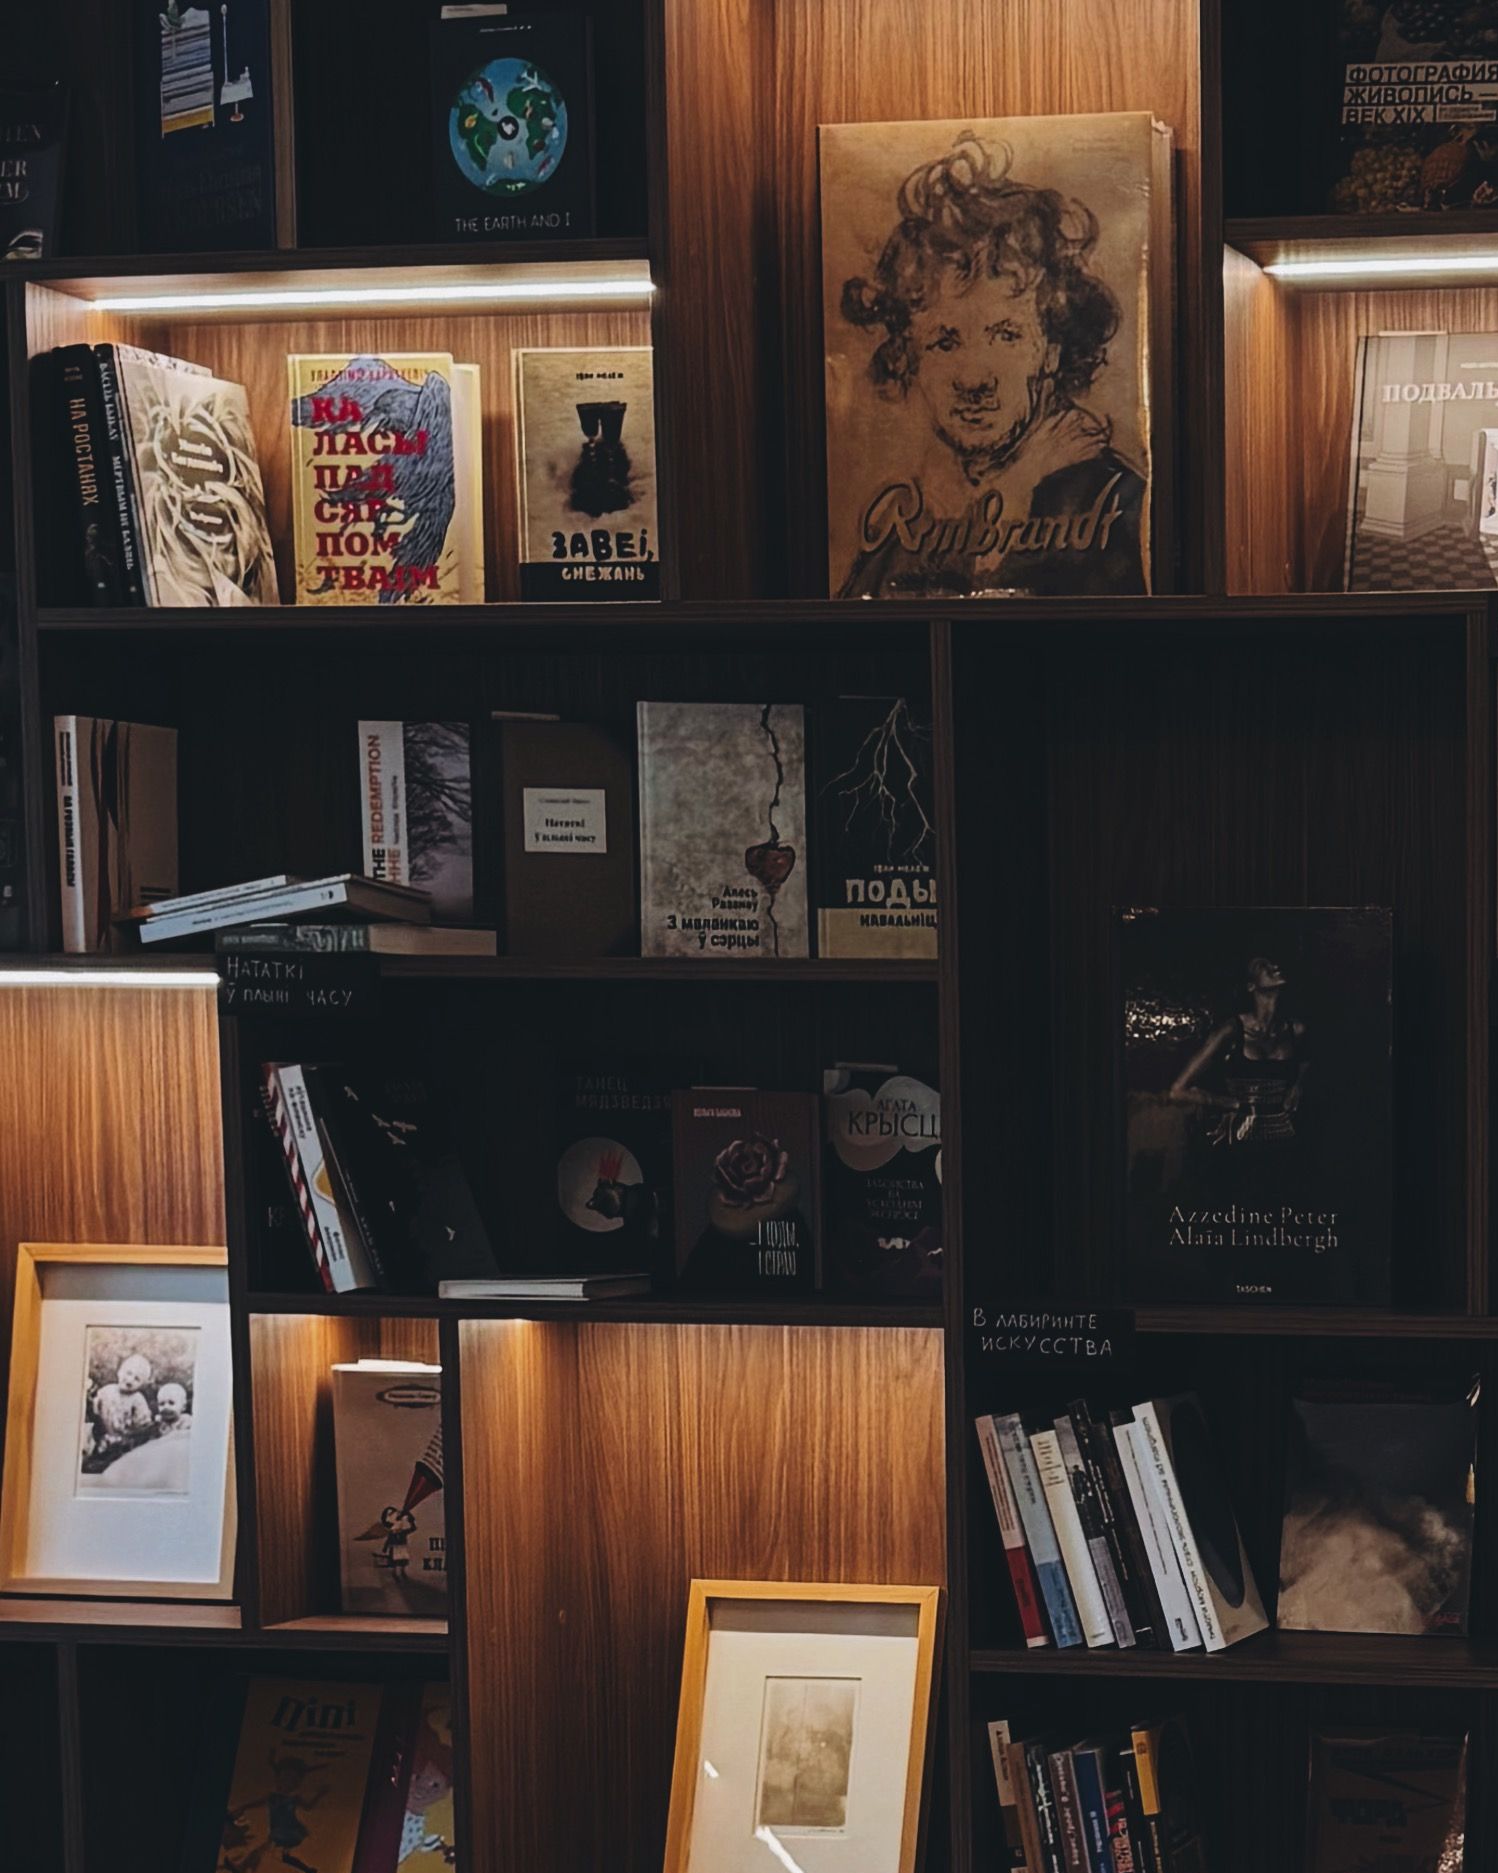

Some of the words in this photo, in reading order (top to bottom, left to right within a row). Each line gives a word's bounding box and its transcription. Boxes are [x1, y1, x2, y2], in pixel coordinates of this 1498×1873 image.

[1348, 86, 1473, 104] ЖИВОПИСЬ
[1346, 107, 1386, 123] ВЕК
[1392, 107, 1425, 122] XIX
[455, 218, 478, 231] THE
[484, 216, 527, 231] EARTH
[531, 214, 560, 228] AND
[69, 397, 88, 421] НА
[312, 395, 363, 422] КА
[313, 430, 428, 456] ЛАСЫ
[72, 422, 100, 507] РОСТАНЯХ
[313, 464, 394, 492] ПАД
[316, 531, 402, 557] ПОМ
[561, 566, 646, 582] СНЕЖАНЬ
[367, 734, 385, 844] REDEMPTION
[371, 848, 386, 881] THE
[1169, 1205, 1273, 1225] Azzedine
[1281, 1206, 1338, 1225] Peter
[1232, 1227, 1338, 1254] Lindbergh
